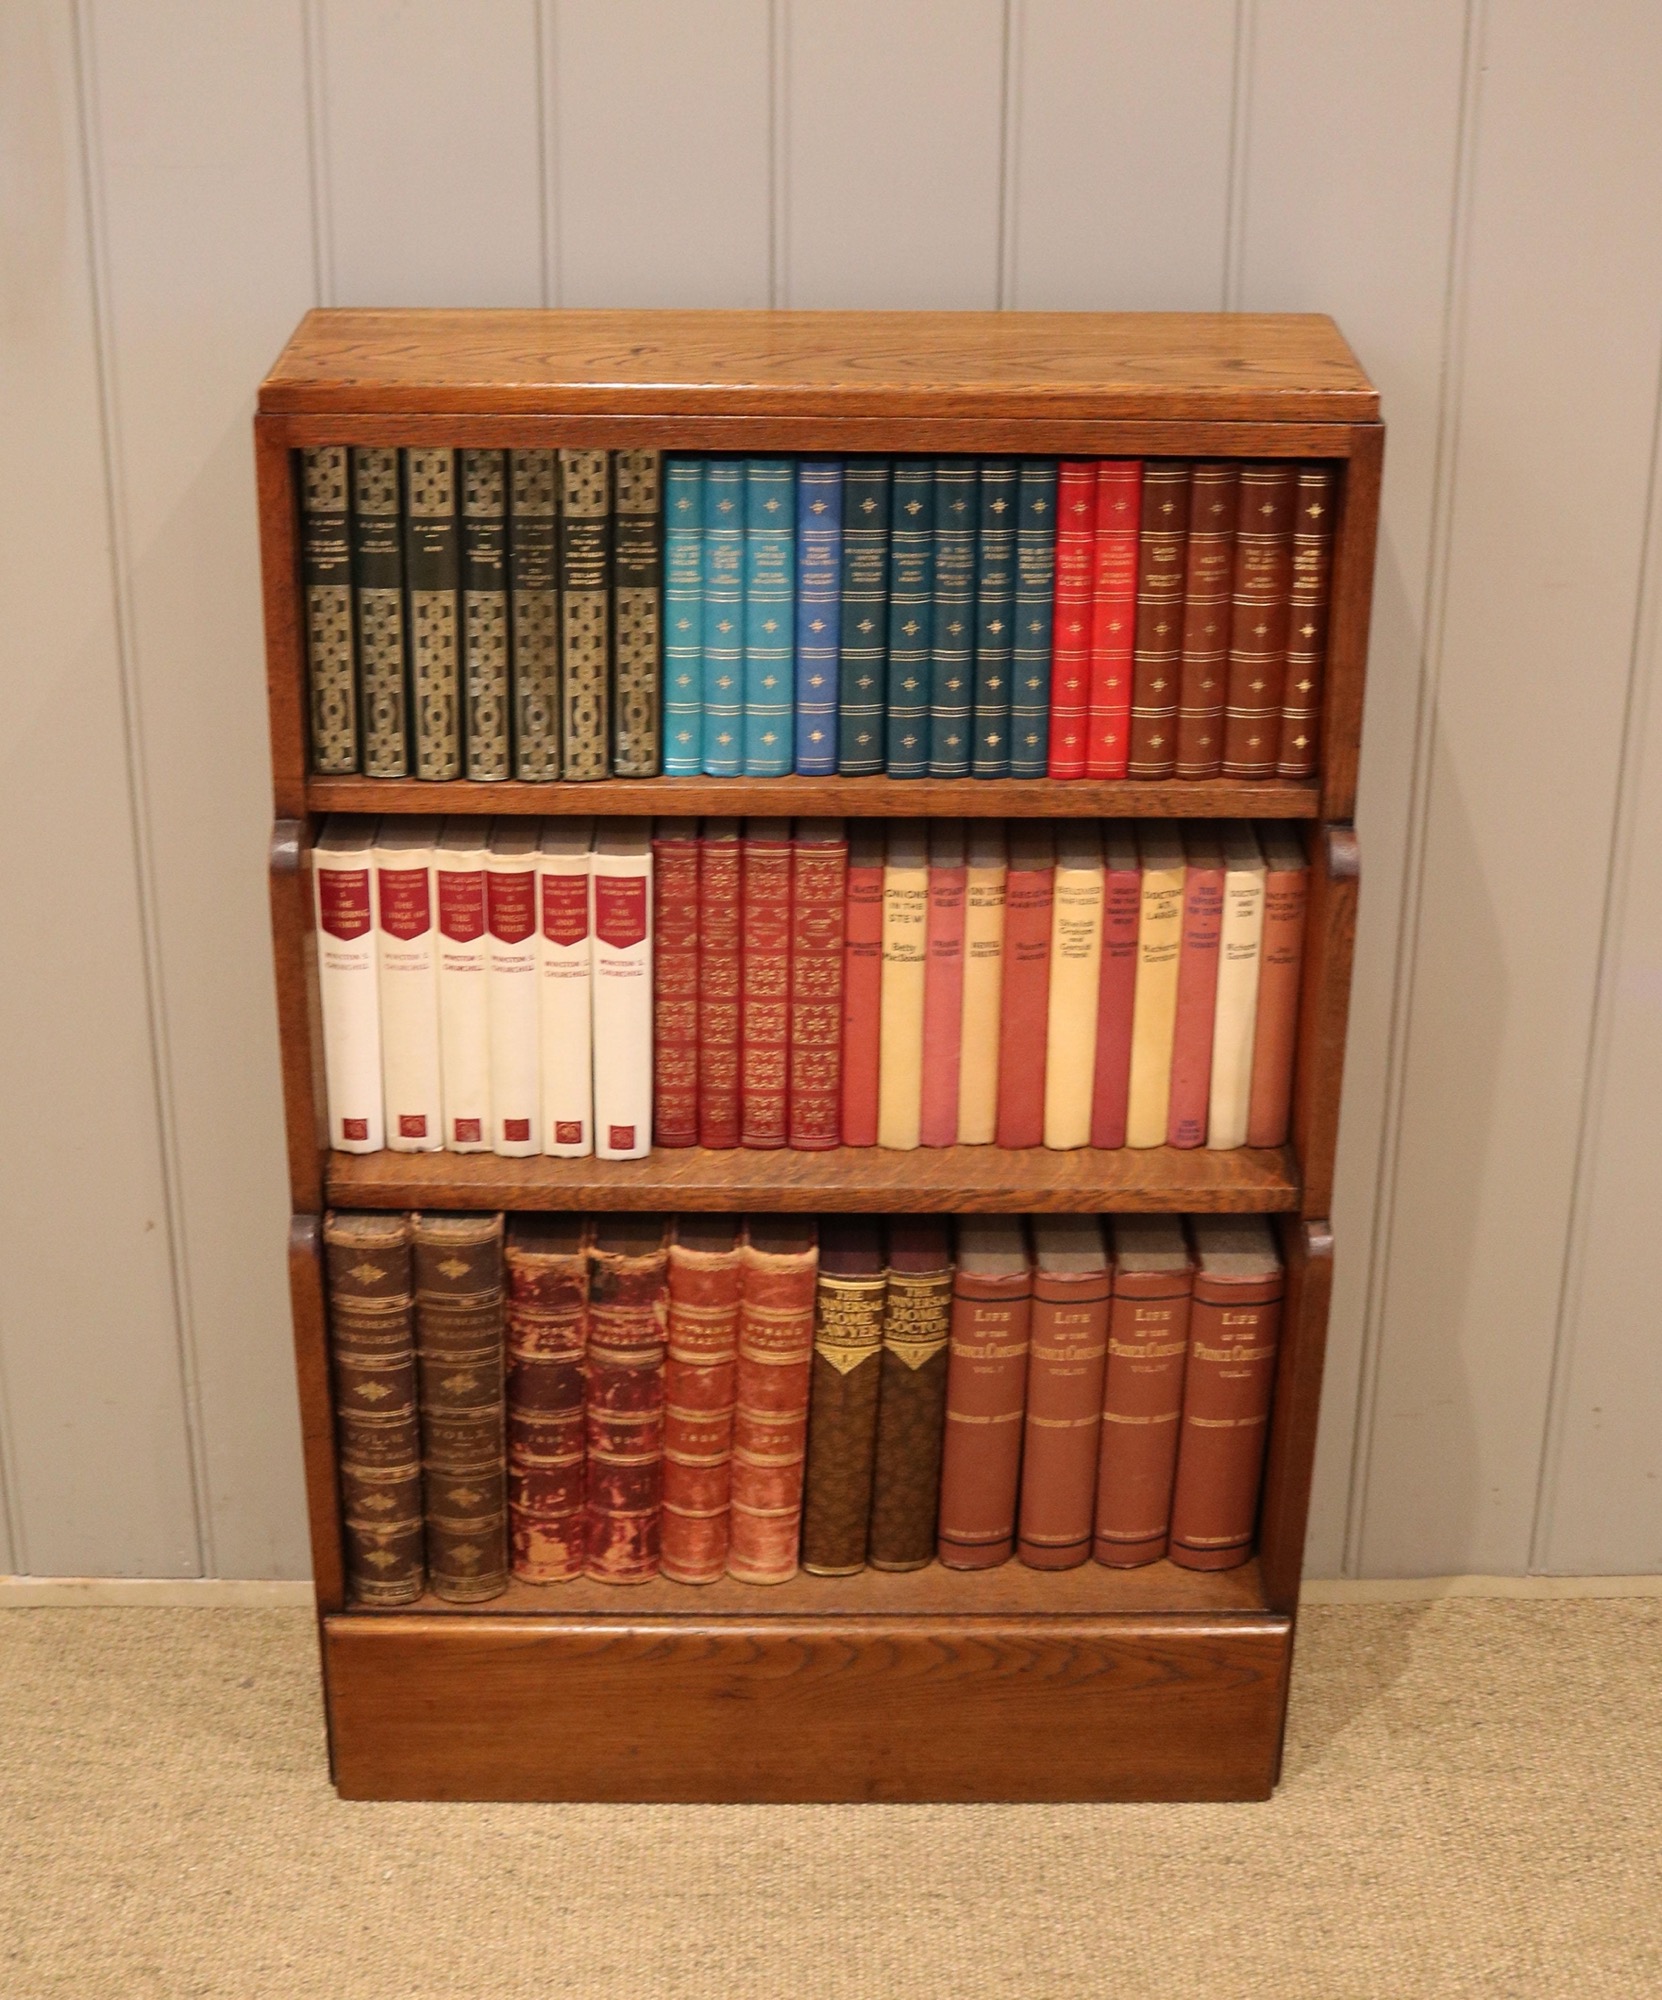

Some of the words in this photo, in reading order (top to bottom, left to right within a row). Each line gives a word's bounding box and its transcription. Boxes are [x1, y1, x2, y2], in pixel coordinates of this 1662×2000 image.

[884, 889, 929, 899] ONIONS
[969, 887, 984, 895] ON
[1143, 888, 1184, 900] DOCTOR
[889, 902, 899, 910] IN
[902, 902, 924, 911] THE
[969, 897, 1007, 907] BEACH
[889, 914, 925, 924] STEW
[892, 942, 917, 954] Betty
[835, 1290, 864, 1300] THE
[905, 1287, 933, 1297] THE
[822, 1310, 874, 1325] HOME
[892, 1306, 943, 1321] HOME
[676, 1322, 733, 1335] STRAND
[746, 1322, 803, 1336] STRAND
[816, 1323, 882, 1338] LAWYER
[883, 1318, 949, 1335] DOCTOR
[1069, 1332, 1089, 1340] THE
[1150, 1329, 1169, 1337] THE
